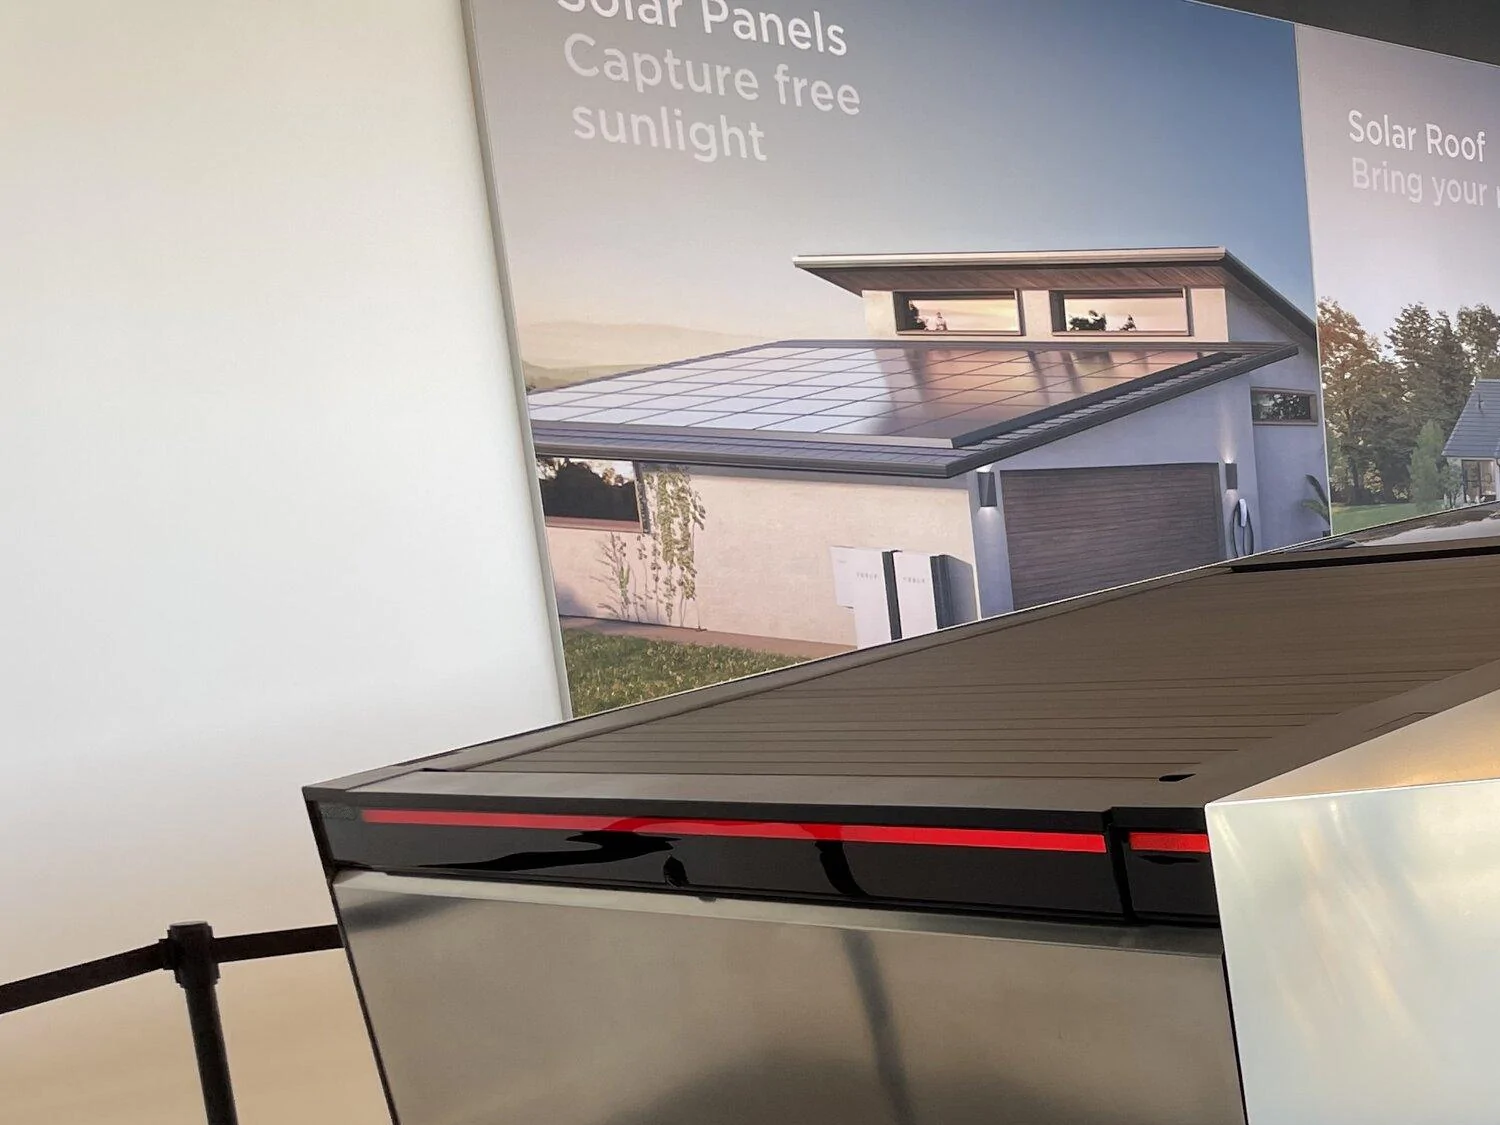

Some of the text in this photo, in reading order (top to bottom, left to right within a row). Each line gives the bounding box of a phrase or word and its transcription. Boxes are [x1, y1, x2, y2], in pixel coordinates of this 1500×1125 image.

[557, 0, 847, 56] oar Panels
[564, 32, 861, 115] Capture free
[573, 106, 768, 162] sunlight
[1348, 110, 1486, 162] Solar Roof
[1352, 157, 1422, 204] Bring
[1431, 176, 1488, 207] your
